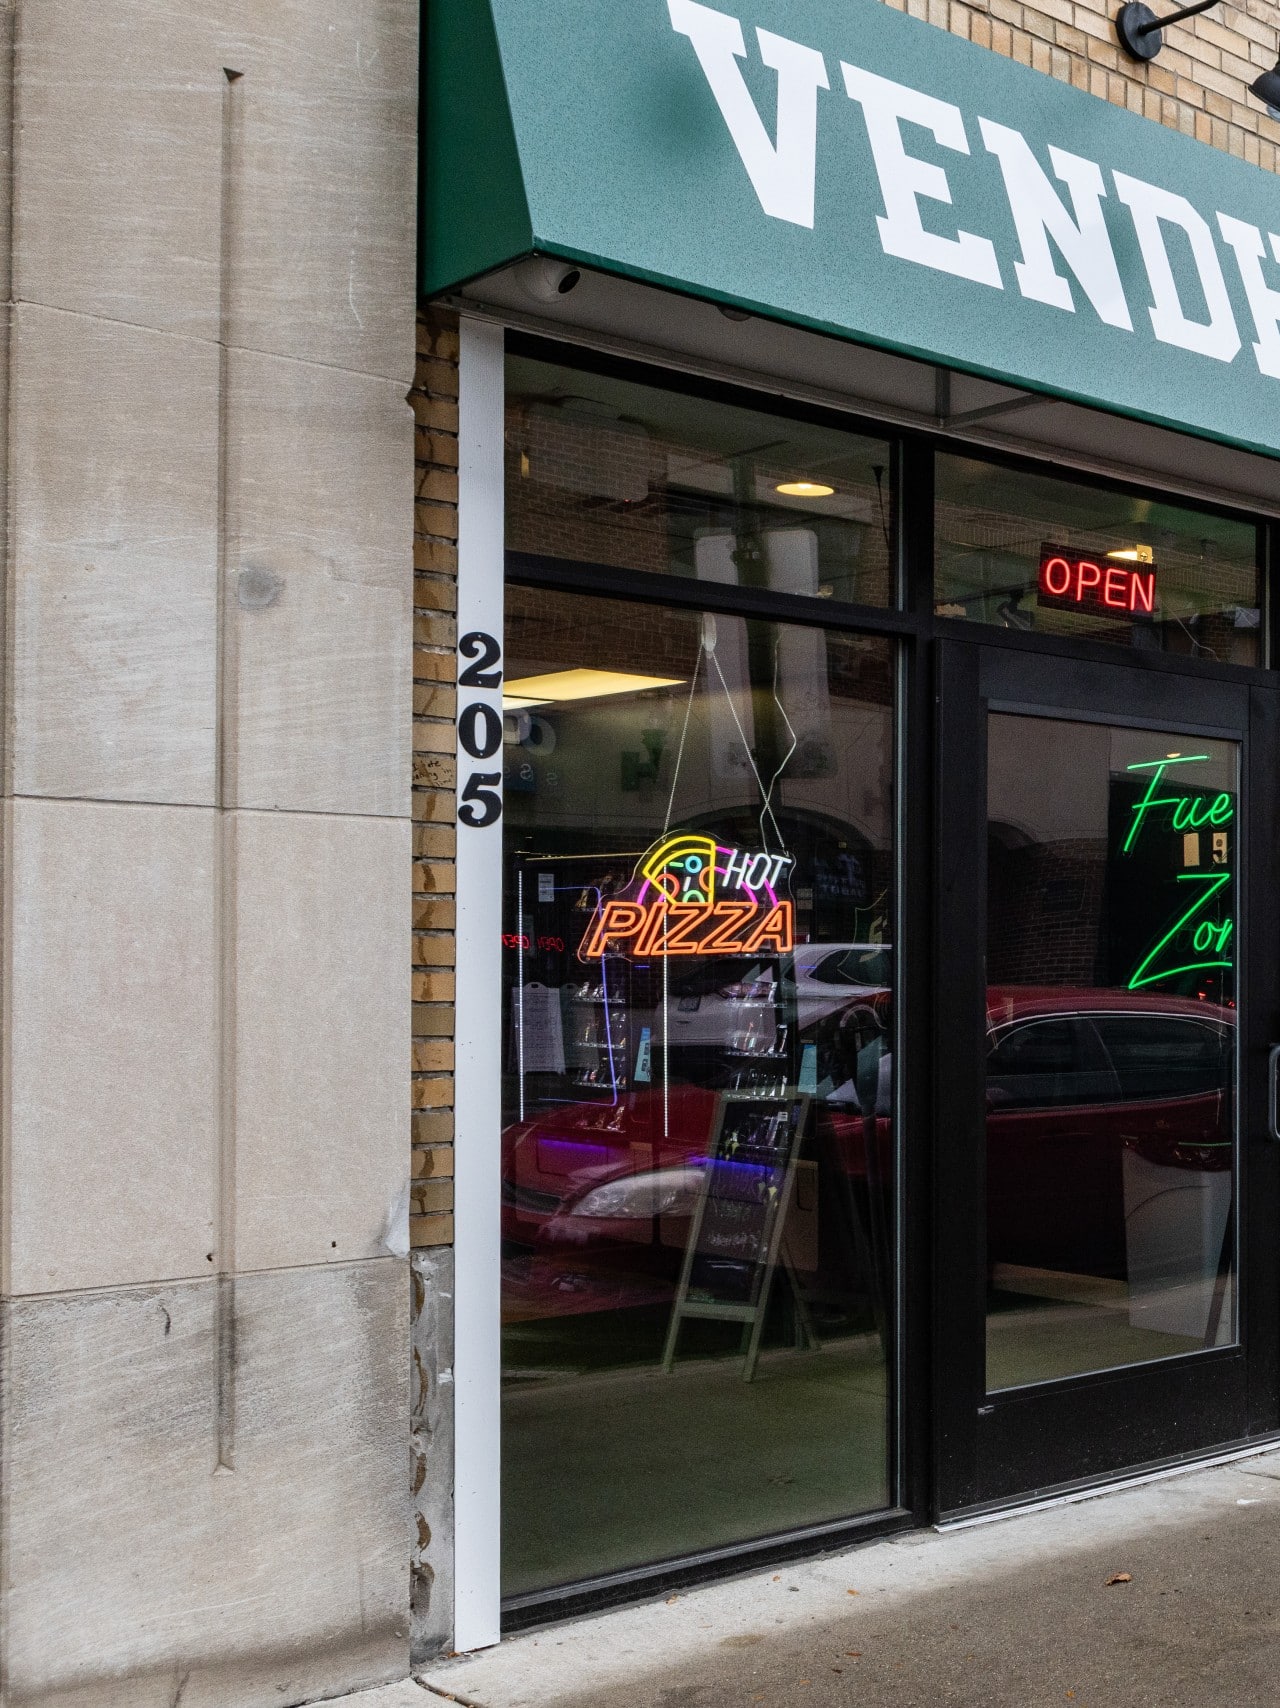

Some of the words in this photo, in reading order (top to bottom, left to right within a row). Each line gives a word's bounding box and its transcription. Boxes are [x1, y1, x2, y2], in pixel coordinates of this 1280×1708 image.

[1045, 558, 1155, 612] OPEN
[458, 631, 502, 828] 205
[1124, 755, 1232, 852] Fue
[722, 848, 792, 890] HOT
[587, 901, 793, 957] PIZZA
